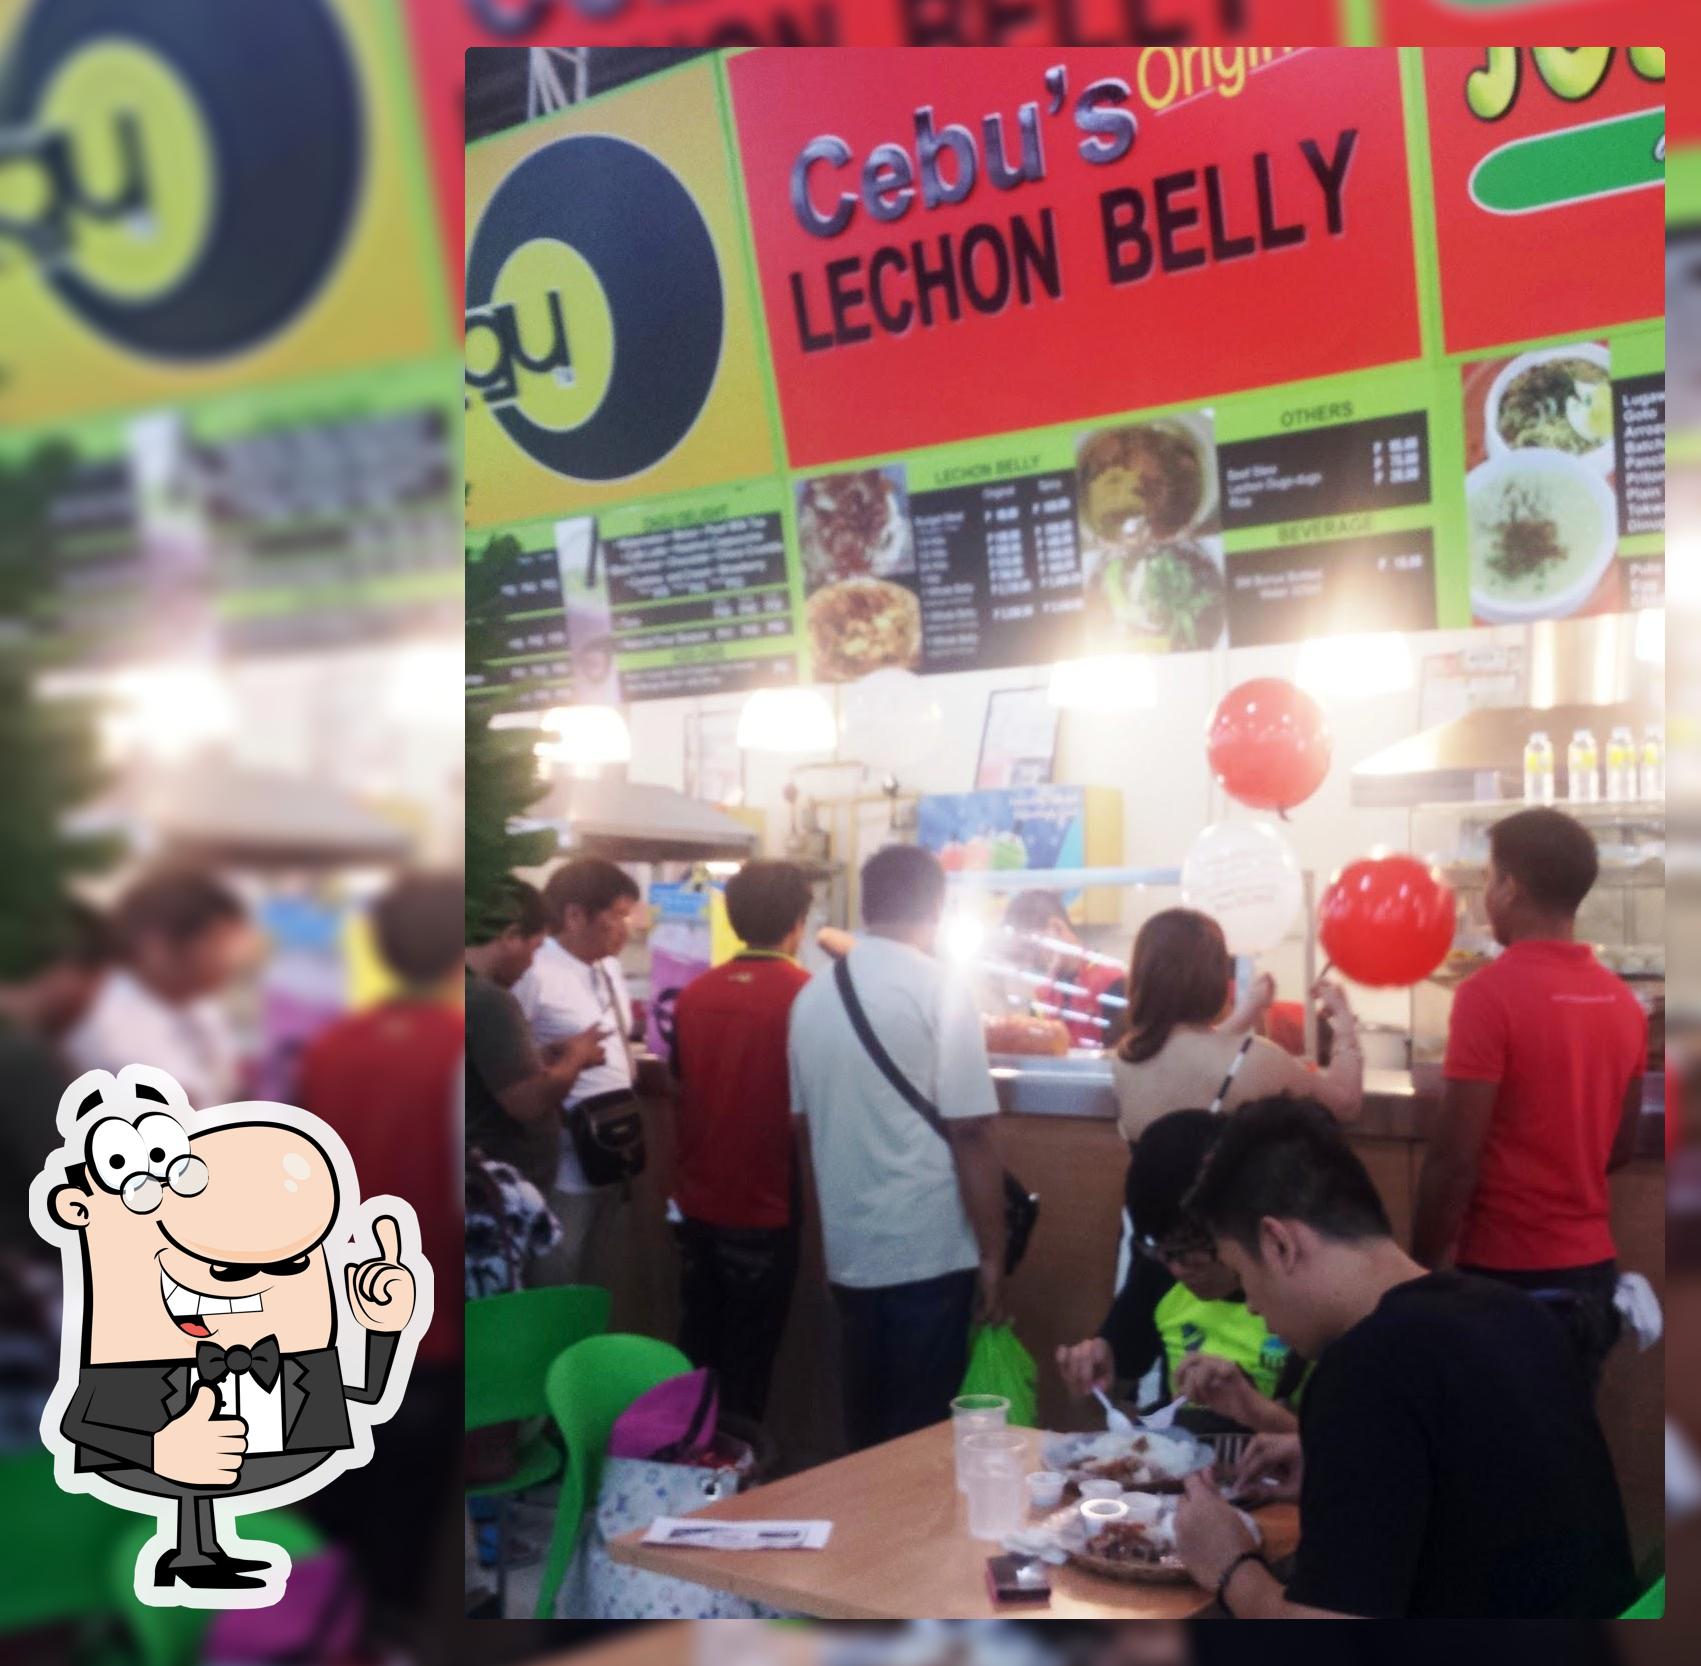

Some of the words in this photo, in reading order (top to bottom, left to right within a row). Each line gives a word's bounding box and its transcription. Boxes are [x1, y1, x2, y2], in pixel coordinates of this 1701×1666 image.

[1137, 47, 1294, 110] Orig
[789, 65, 1138, 238] Cebu's
[788, 208, 1063, 354] LECHON
[1099, 129, 1359, 286] BELLY
[1281, 401, 1354, 427] OTHERS
[934, 463, 992, 484] LECHON
[995, 454, 1040, 475] BELLY
[1278, 513, 1372, 542] BEVERAGE
